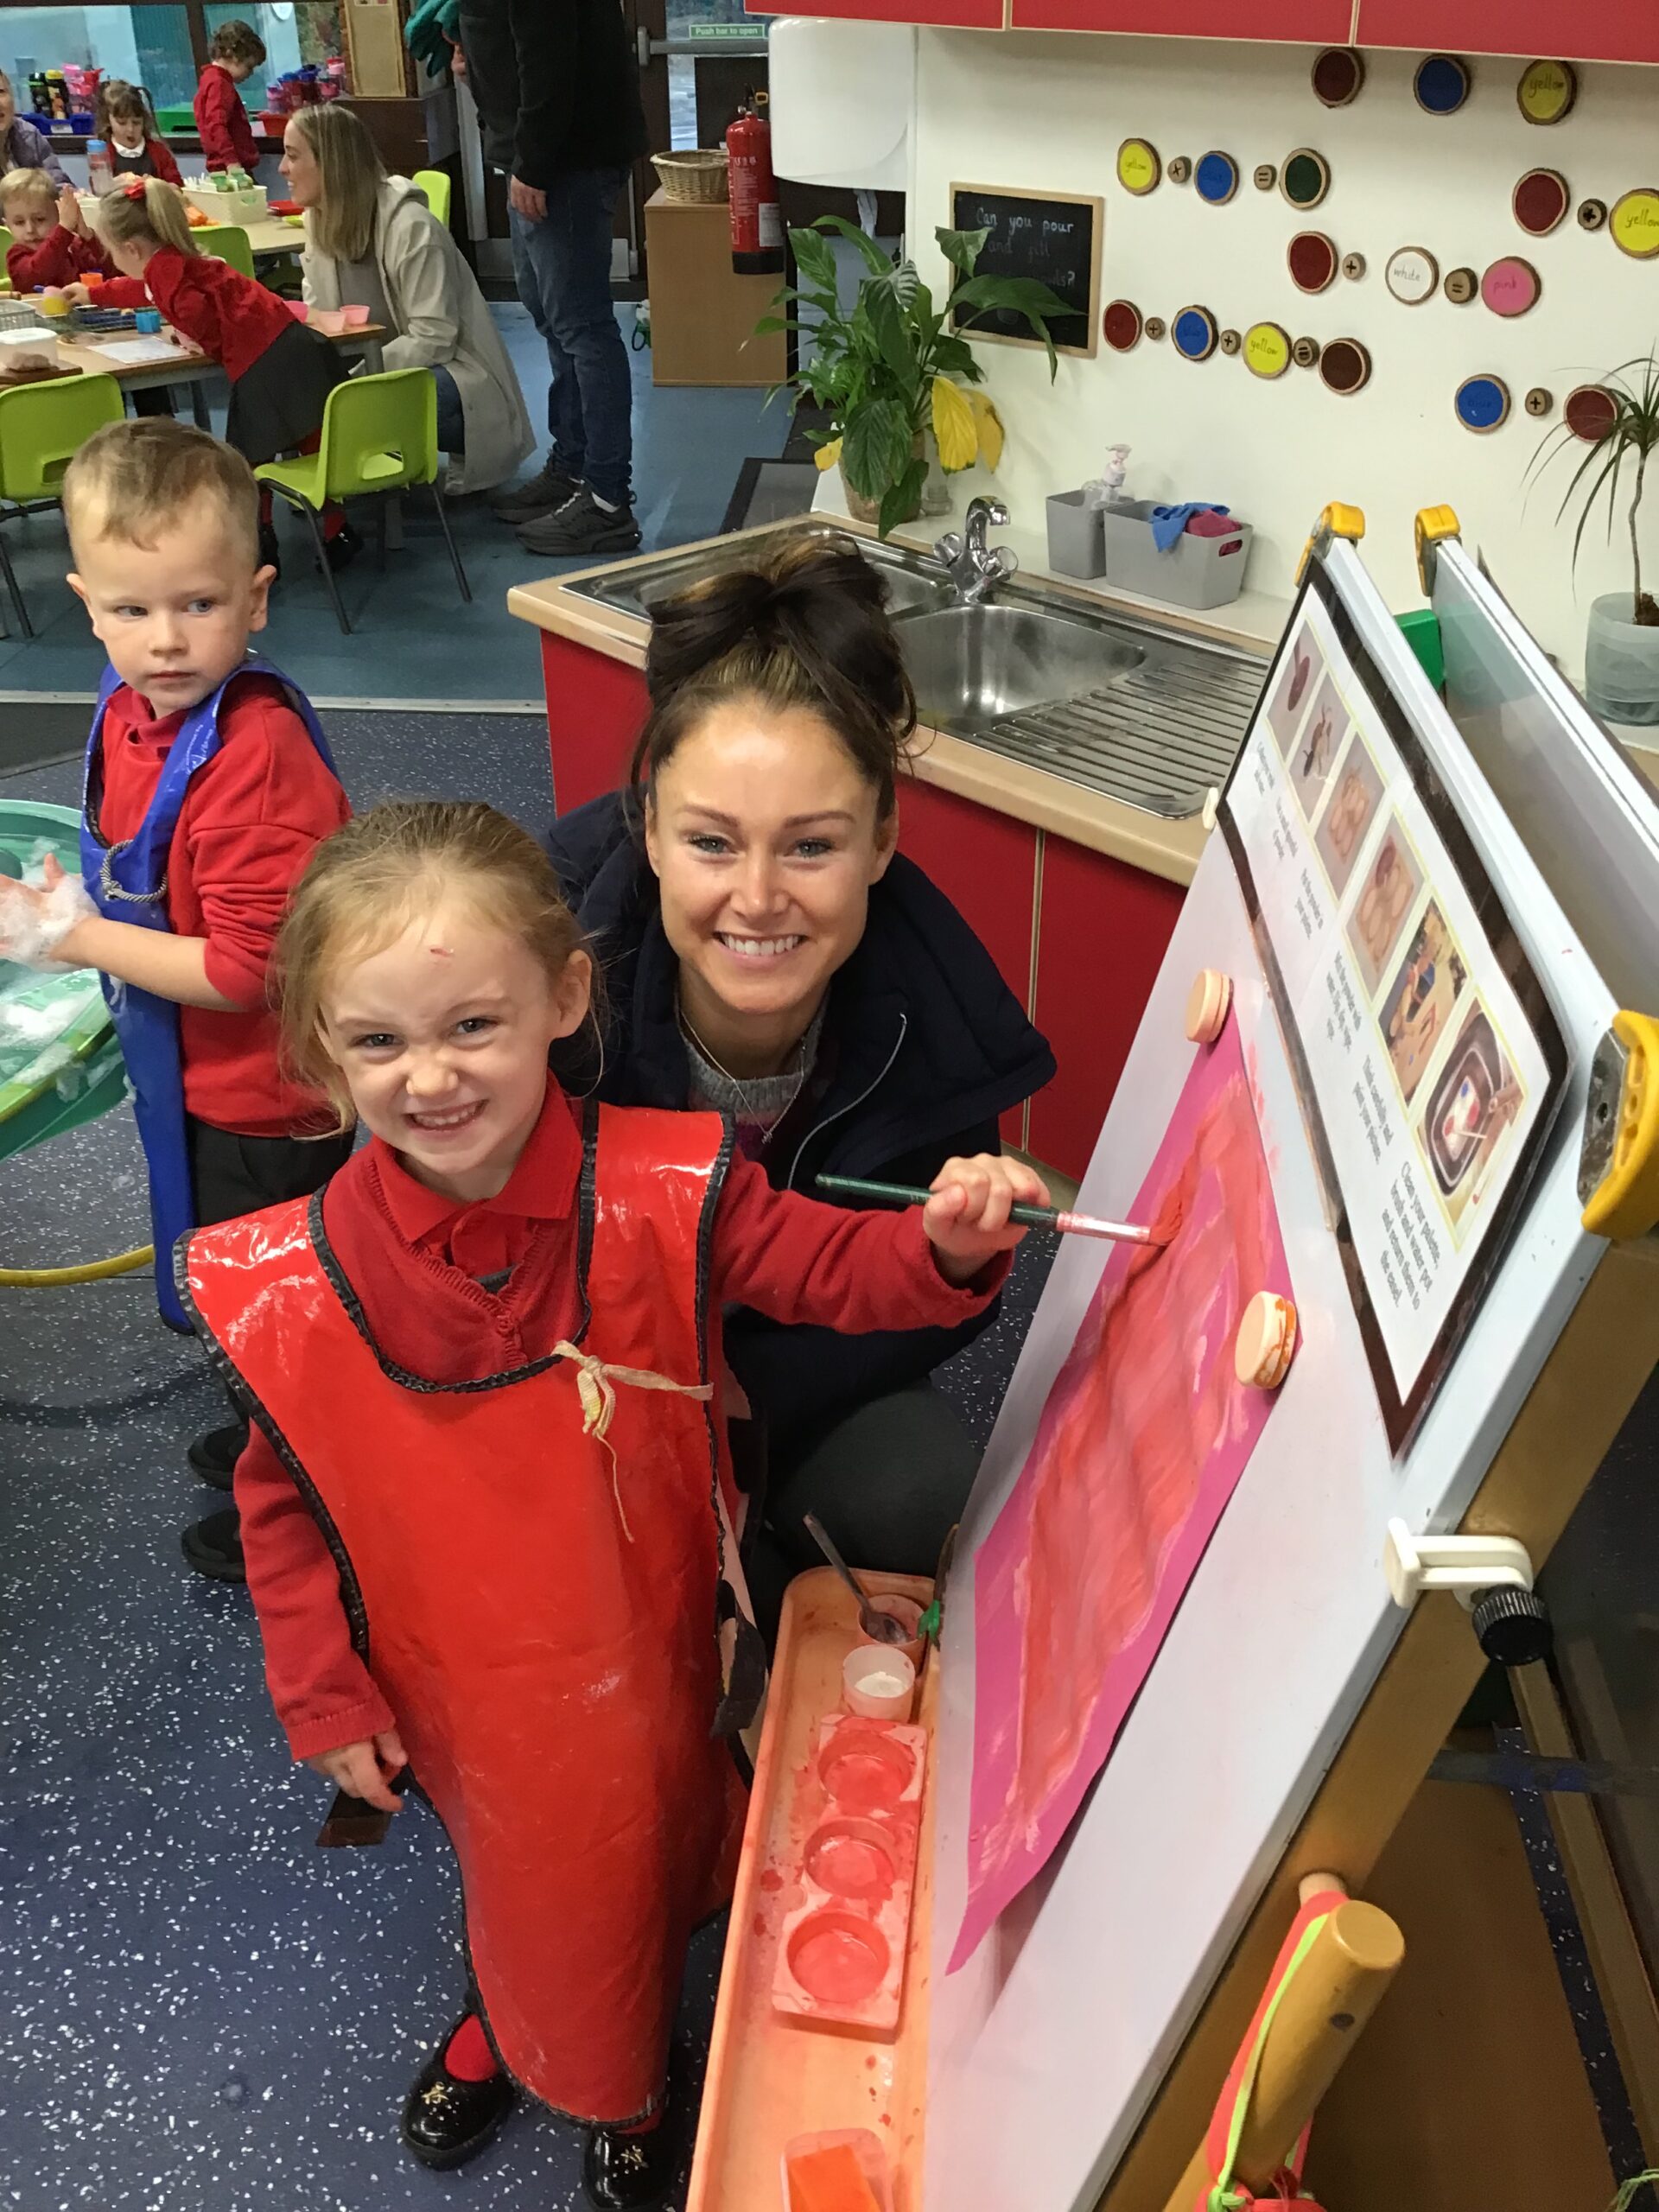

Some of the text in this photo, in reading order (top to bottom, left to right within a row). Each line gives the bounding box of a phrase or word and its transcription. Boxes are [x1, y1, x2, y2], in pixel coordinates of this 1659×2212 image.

[695, 27, 715, 35] Push
[738, 27, 758, 35] open
[976, 207, 1075, 237] Can you pour
[988, 236, 1051, 264] and fill
[1393, 264, 1421, 283] white
[1249, 337, 1280, 357] yellow
[1342, 981, 1356, 1013] powder
[1352, 1081, 1365, 1109] paint
[1359, 1102, 1371, 1129] your
[1363, 1053, 1395, 1147] Think carefully and
[1401, 1160, 1440, 1271] Clean your palette,
[1390, 1179, 1433, 1293] brush and water pot
[1380, 1249, 1402, 1308] the easel.
[1382, 1208, 1421, 1311] and return them to
